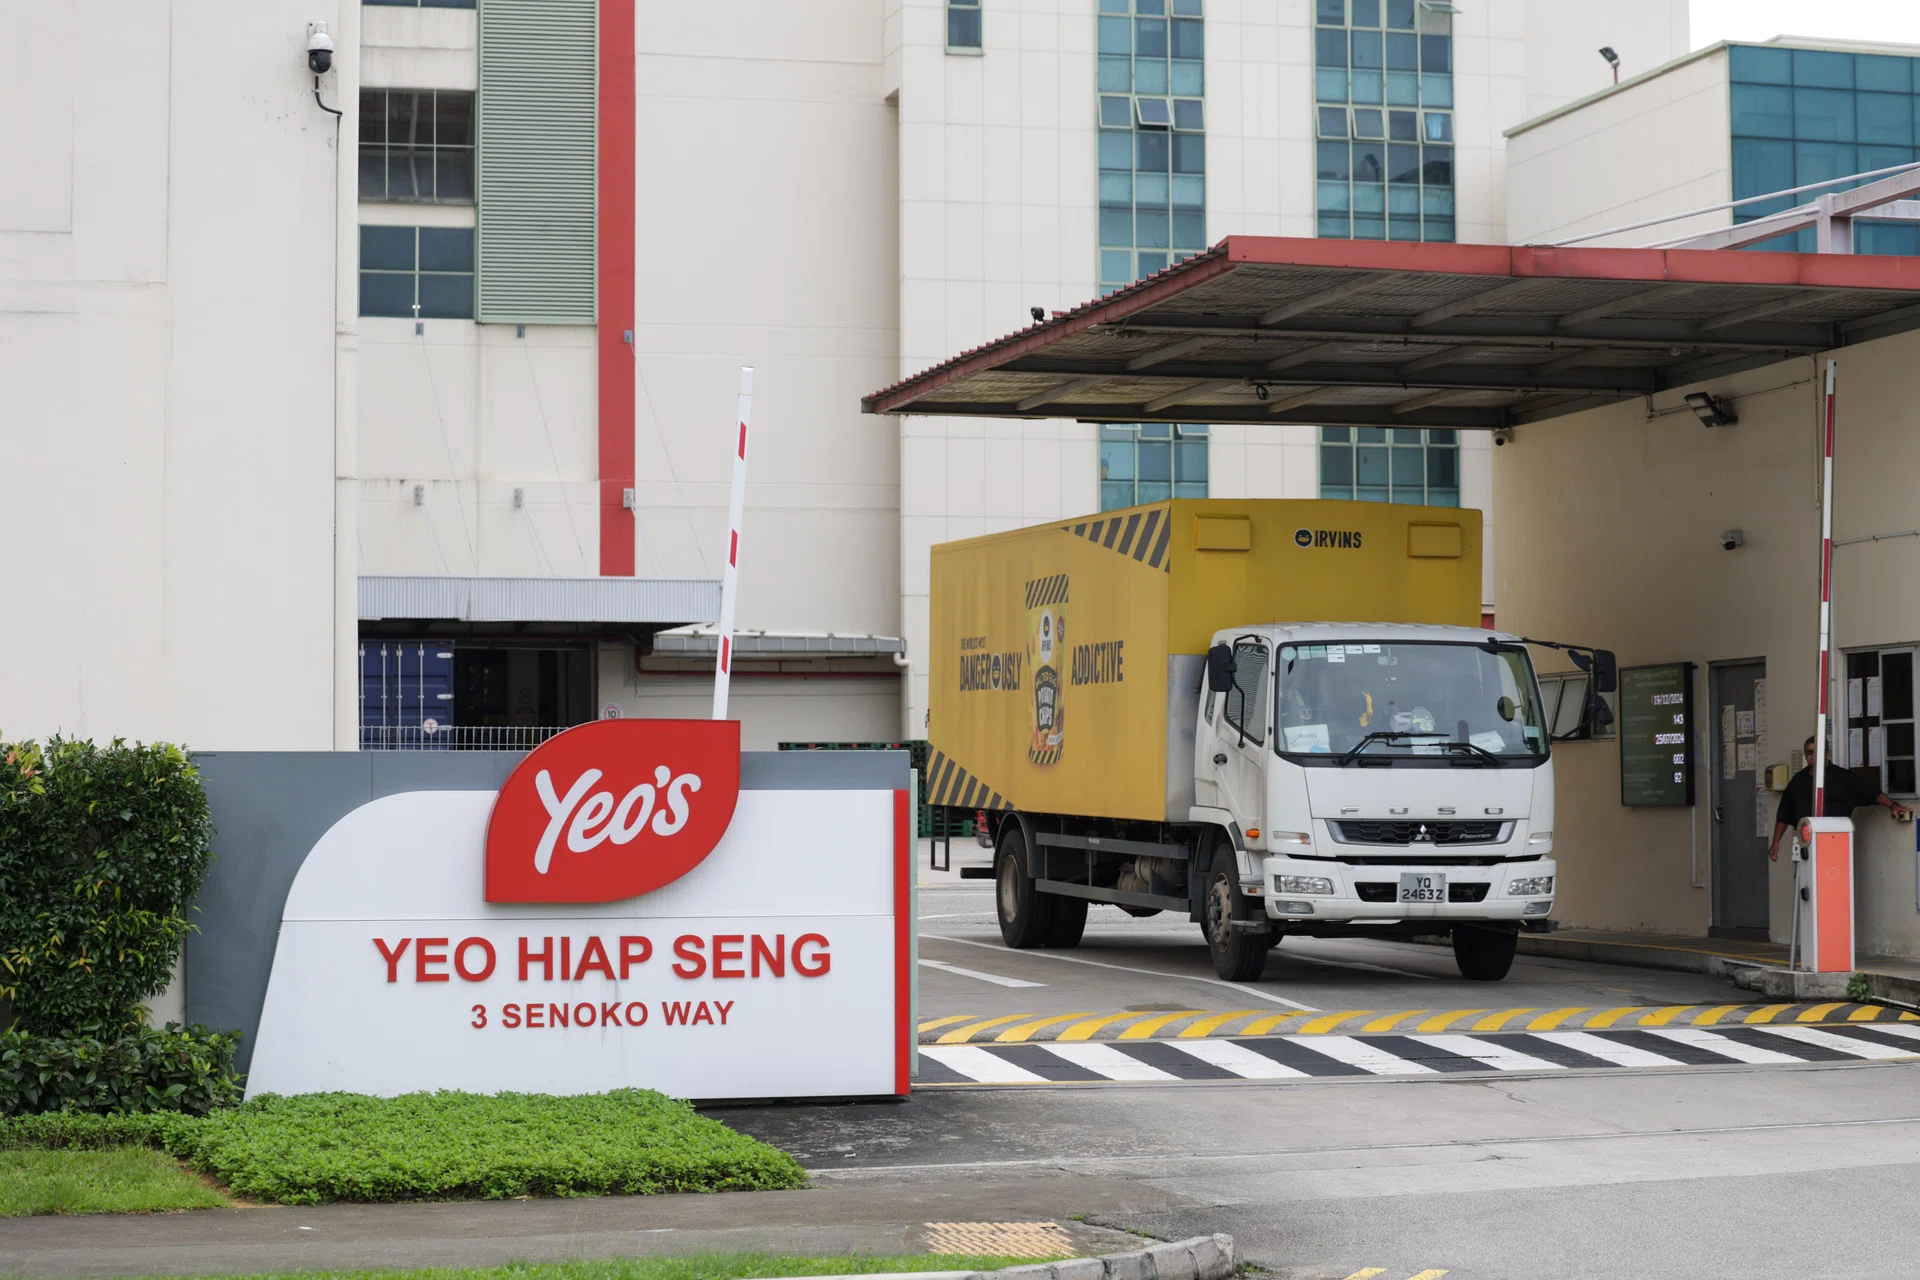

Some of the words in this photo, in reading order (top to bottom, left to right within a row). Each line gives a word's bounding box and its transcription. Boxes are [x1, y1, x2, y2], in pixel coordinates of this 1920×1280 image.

[1314, 530, 1362, 549] IRVINS
[1071, 640, 1124, 686] ADDICTIVE
[608, 710, 617, 719] 10
[534, 765, 701, 875] Yeo's
[1340, 806, 1504, 815] FUSO
[1416, 877, 1432, 889] YQ
[1402, 888, 1444, 900] 2463Z
[372, 937, 497, 983] YEO
[518, 935, 653, 981] HIAP
[672, 933, 831, 979] SENG
[471, 1004, 488, 1029] 3
[502, 1001, 649, 1028] SENOKO
[662, 1000, 735, 1026] WAY
